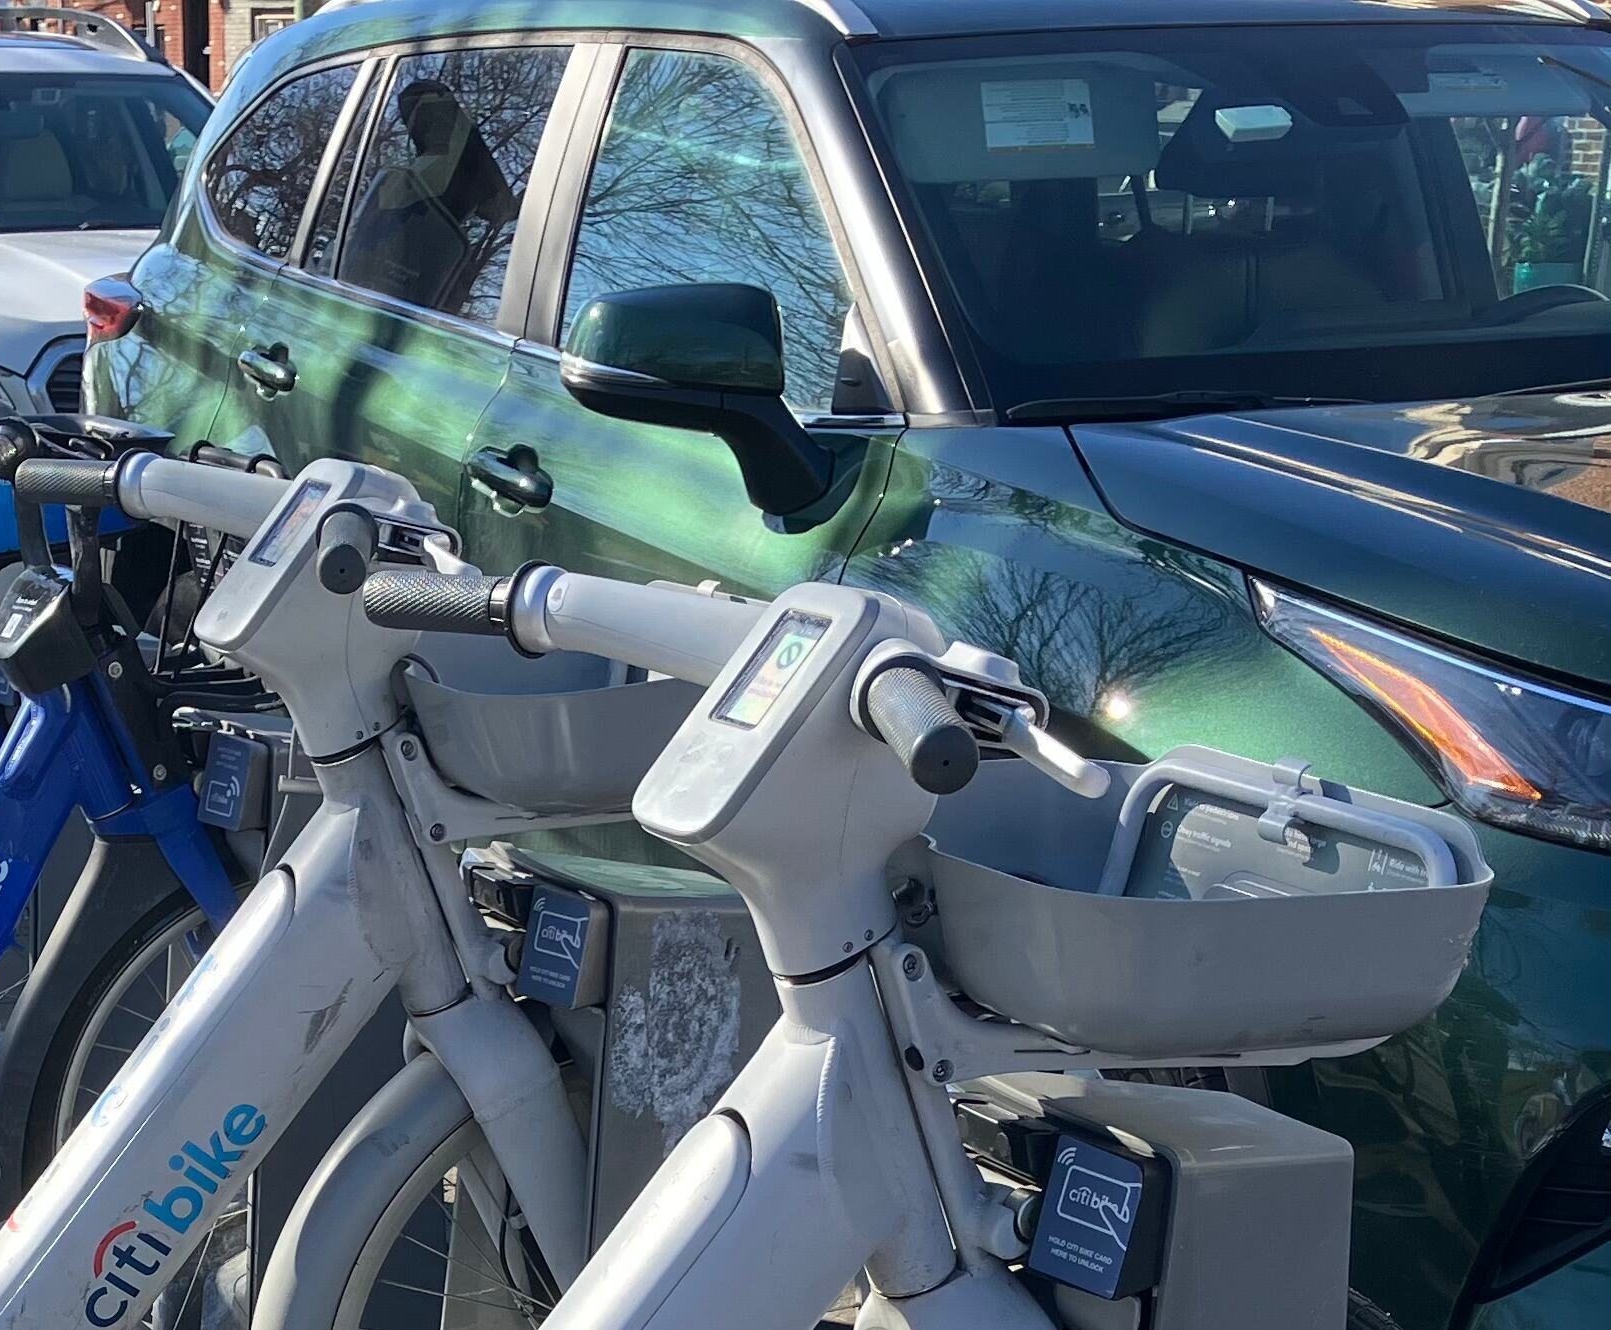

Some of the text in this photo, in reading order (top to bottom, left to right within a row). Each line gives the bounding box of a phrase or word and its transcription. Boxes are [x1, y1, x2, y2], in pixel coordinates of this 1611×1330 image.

[1069, 1186, 1092, 1207] citi
[84, 1103, 268, 1329] citi bike
[1047, 1235, 1067, 1248] HOLD
[1078, 1247, 1095, 1259] BIKE
[1093, 1253, 1113, 1265] CARD
[1068, 1254, 1078, 1263] TO
[1077, 1257, 1105, 1274] UNLOCK
